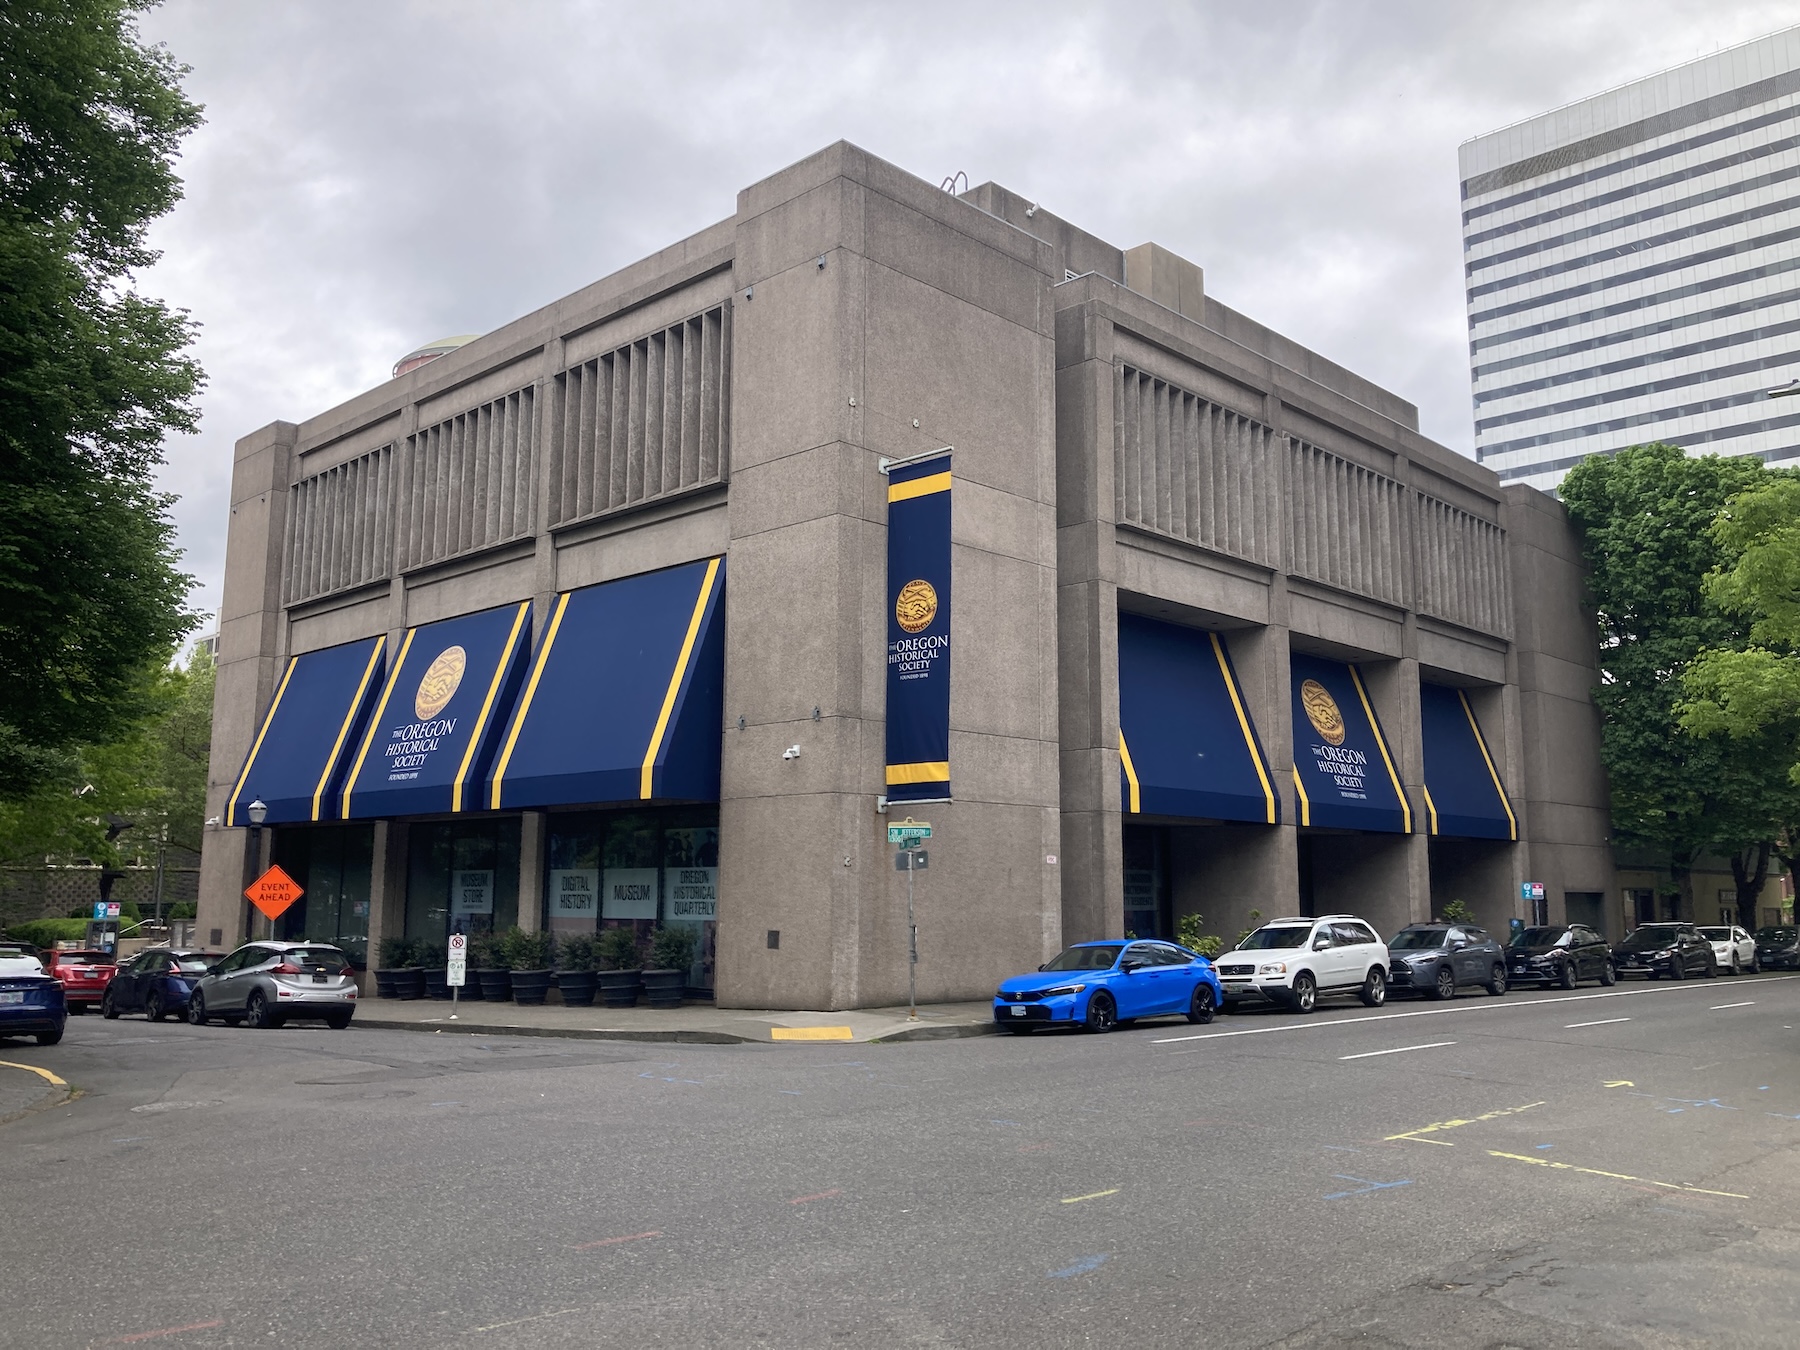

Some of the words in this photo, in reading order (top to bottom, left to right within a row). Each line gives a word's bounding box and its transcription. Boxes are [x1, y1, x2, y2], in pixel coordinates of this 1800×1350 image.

[896, 634, 949, 653] OREGON
[888, 649, 939, 665] HISTORICAL
[898, 660, 931, 672] SOCIETY
[401, 718, 458, 741] OREGON
[385, 738, 440, 757] HISTORICAL
[1321, 745, 1368, 765] OREGON
[391, 753, 428, 769] SOCIETY
[1317, 760, 1366, 778] HISTORICAL
[1333, 775, 1364, 788] SOCIETY
[902, 828, 925, 837] JEFFERSON
[460, 873, 488, 888] MUSEUM
[561, 875, 591, 892] DIGITAL
[679, 870, 710, 884] OREGON
[261, 883, 290, 891] EVENT
[613, 885, 650, 901] MUSEUM
[673, 886, 717, 900] HISTORICAL
[258, 893, 291, 901] AHEAD
[463, 889, 484, 903] STORE
[559, 894, 592, 909] HISTORY
[673, 901, 716, 916] QUARTERLY
